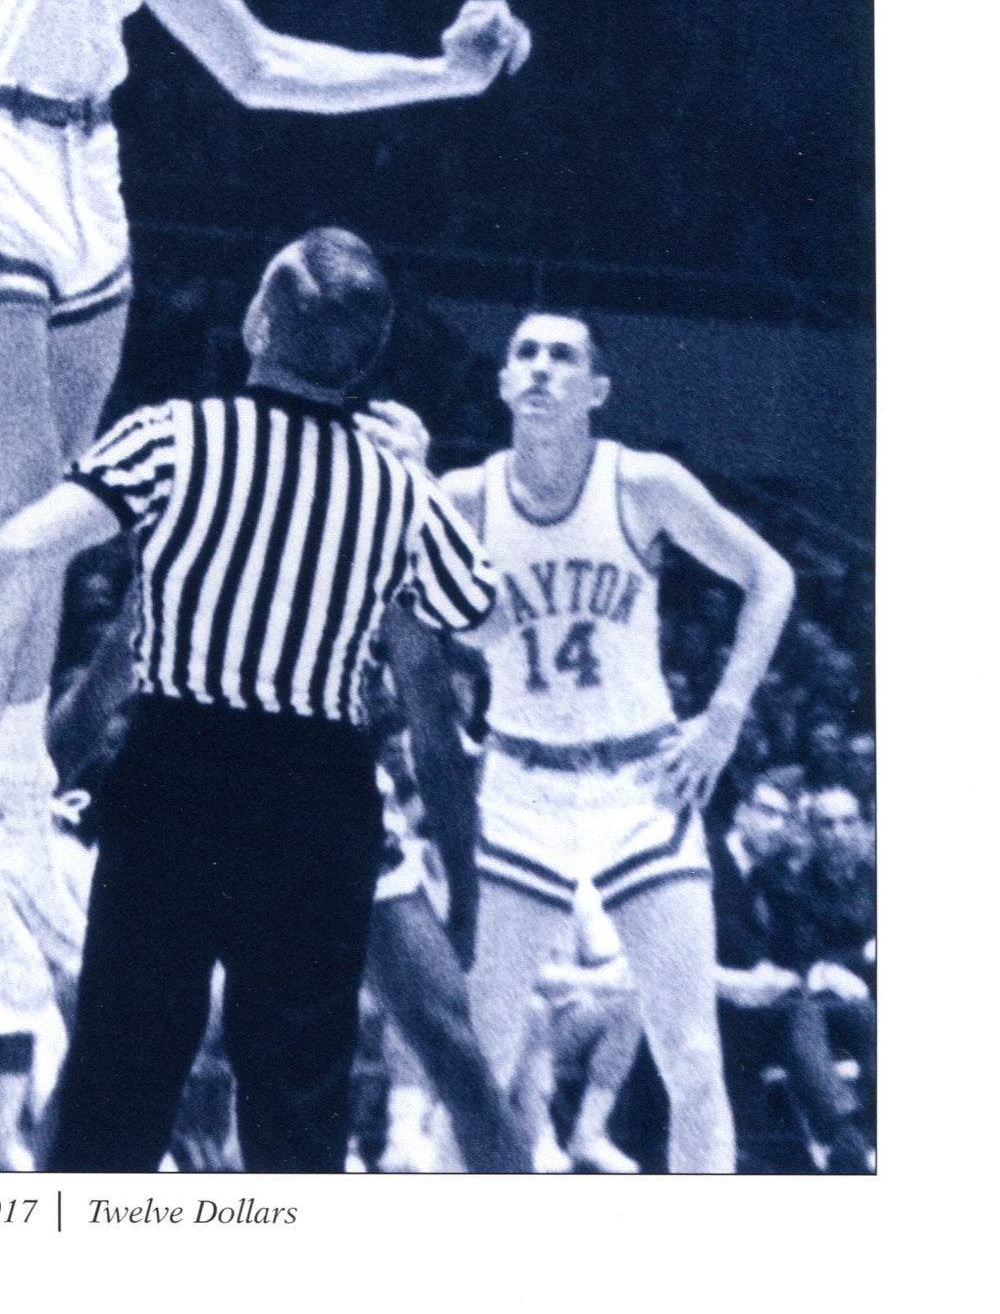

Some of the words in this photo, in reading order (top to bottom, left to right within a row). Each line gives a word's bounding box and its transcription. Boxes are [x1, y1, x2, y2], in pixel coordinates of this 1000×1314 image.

[503, 558, 643, 624] AYTON
[519, 621, 602, 693] 14
[88, 1197, 184, 1224] Twelve
[192, 1197, 299, 1224] Dollars
